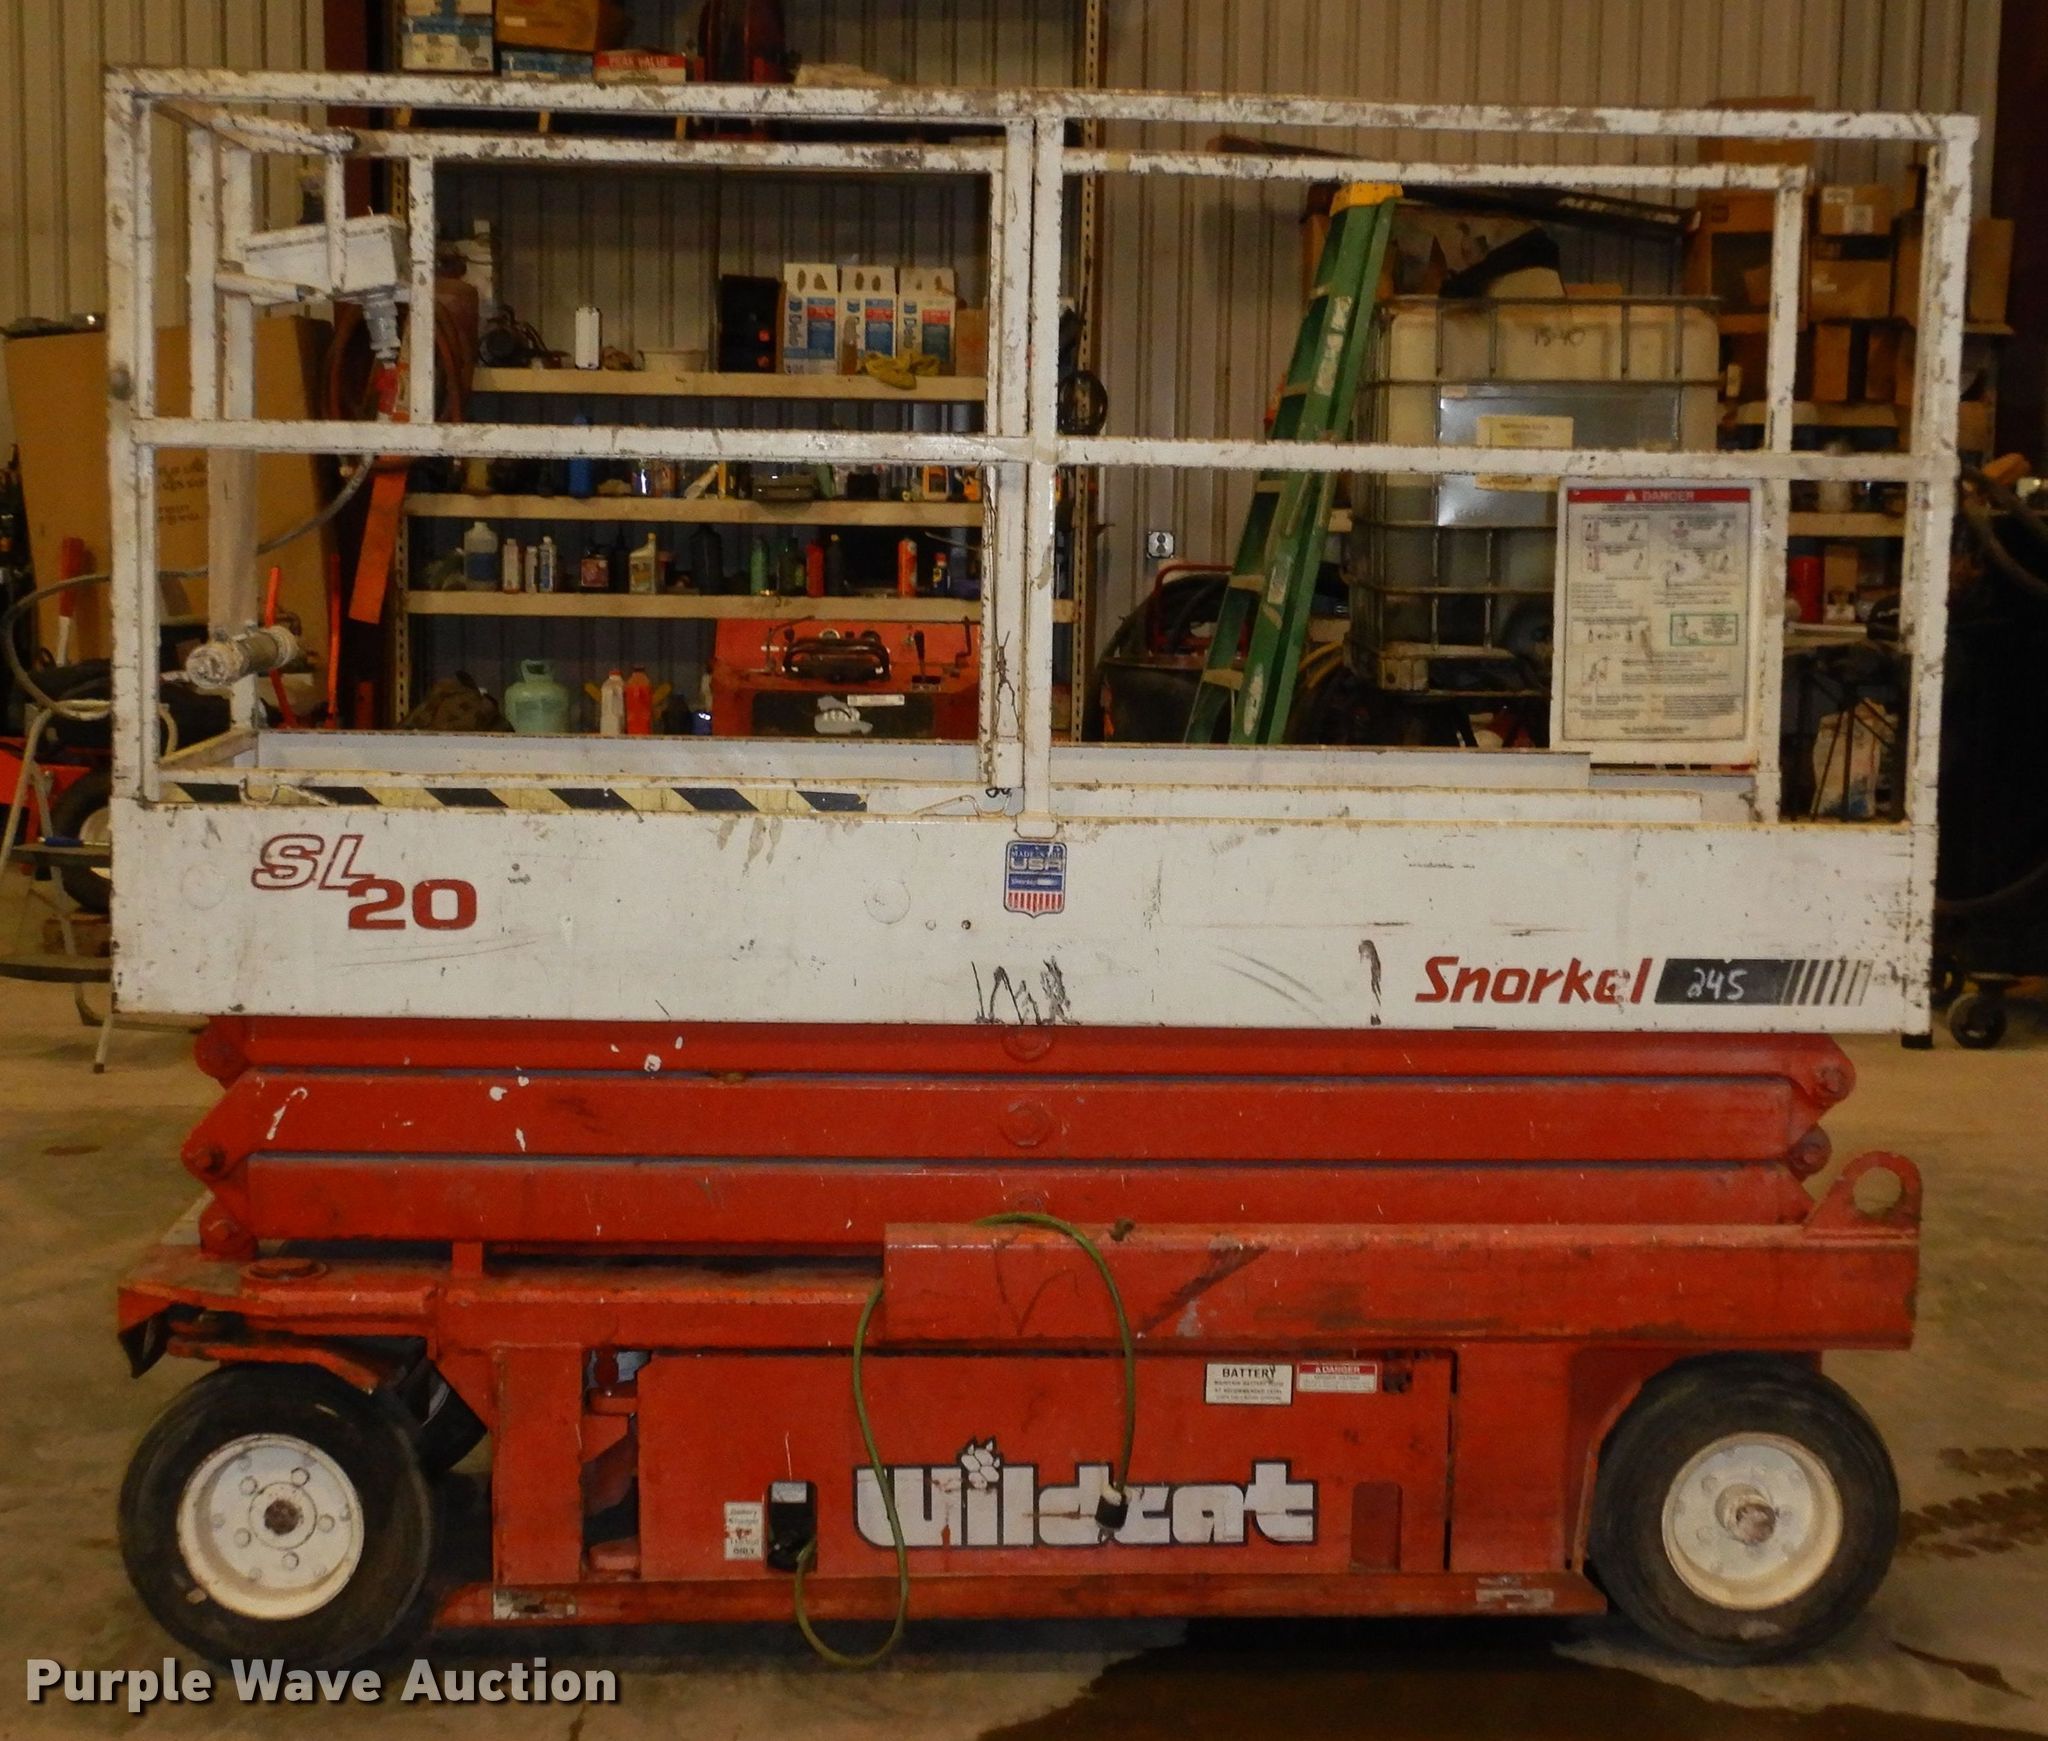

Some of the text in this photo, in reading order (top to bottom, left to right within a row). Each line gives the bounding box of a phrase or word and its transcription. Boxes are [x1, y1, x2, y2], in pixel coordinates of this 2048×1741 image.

[1642, 490, 1695, 502] DANGER
[250, 833, 375, 891] SL
[347, 879, 478, 931] 20
[1415, 956, 1653, 1005] Snorkel
[1687, 966, 1746, 1001] 245
[1222, 1367, 1276, 1379] BATTERY
[1322, 1366, 1361, 1375] DANGER
